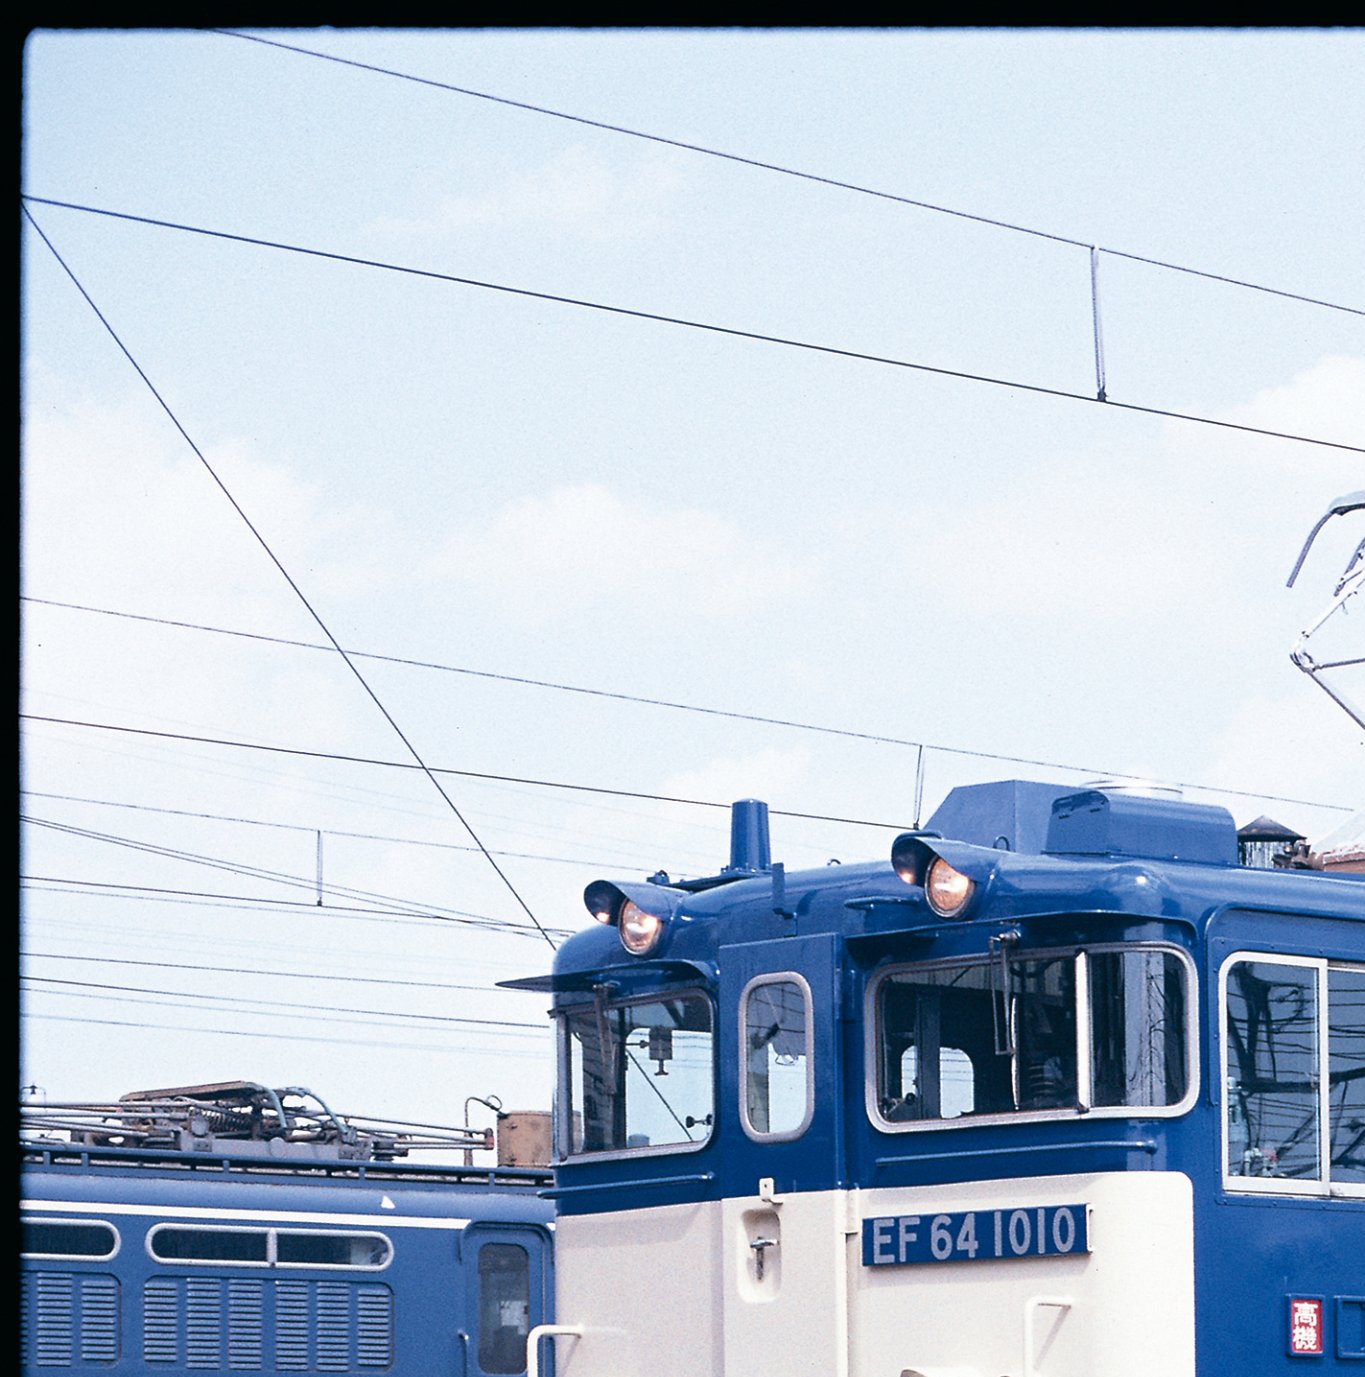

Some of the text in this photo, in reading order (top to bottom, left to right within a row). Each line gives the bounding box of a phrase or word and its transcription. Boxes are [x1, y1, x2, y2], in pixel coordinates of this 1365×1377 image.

[873, 1207, 1076, 1264] EF 64 1010
[1293, 1303, 1318, 1350] 高機
